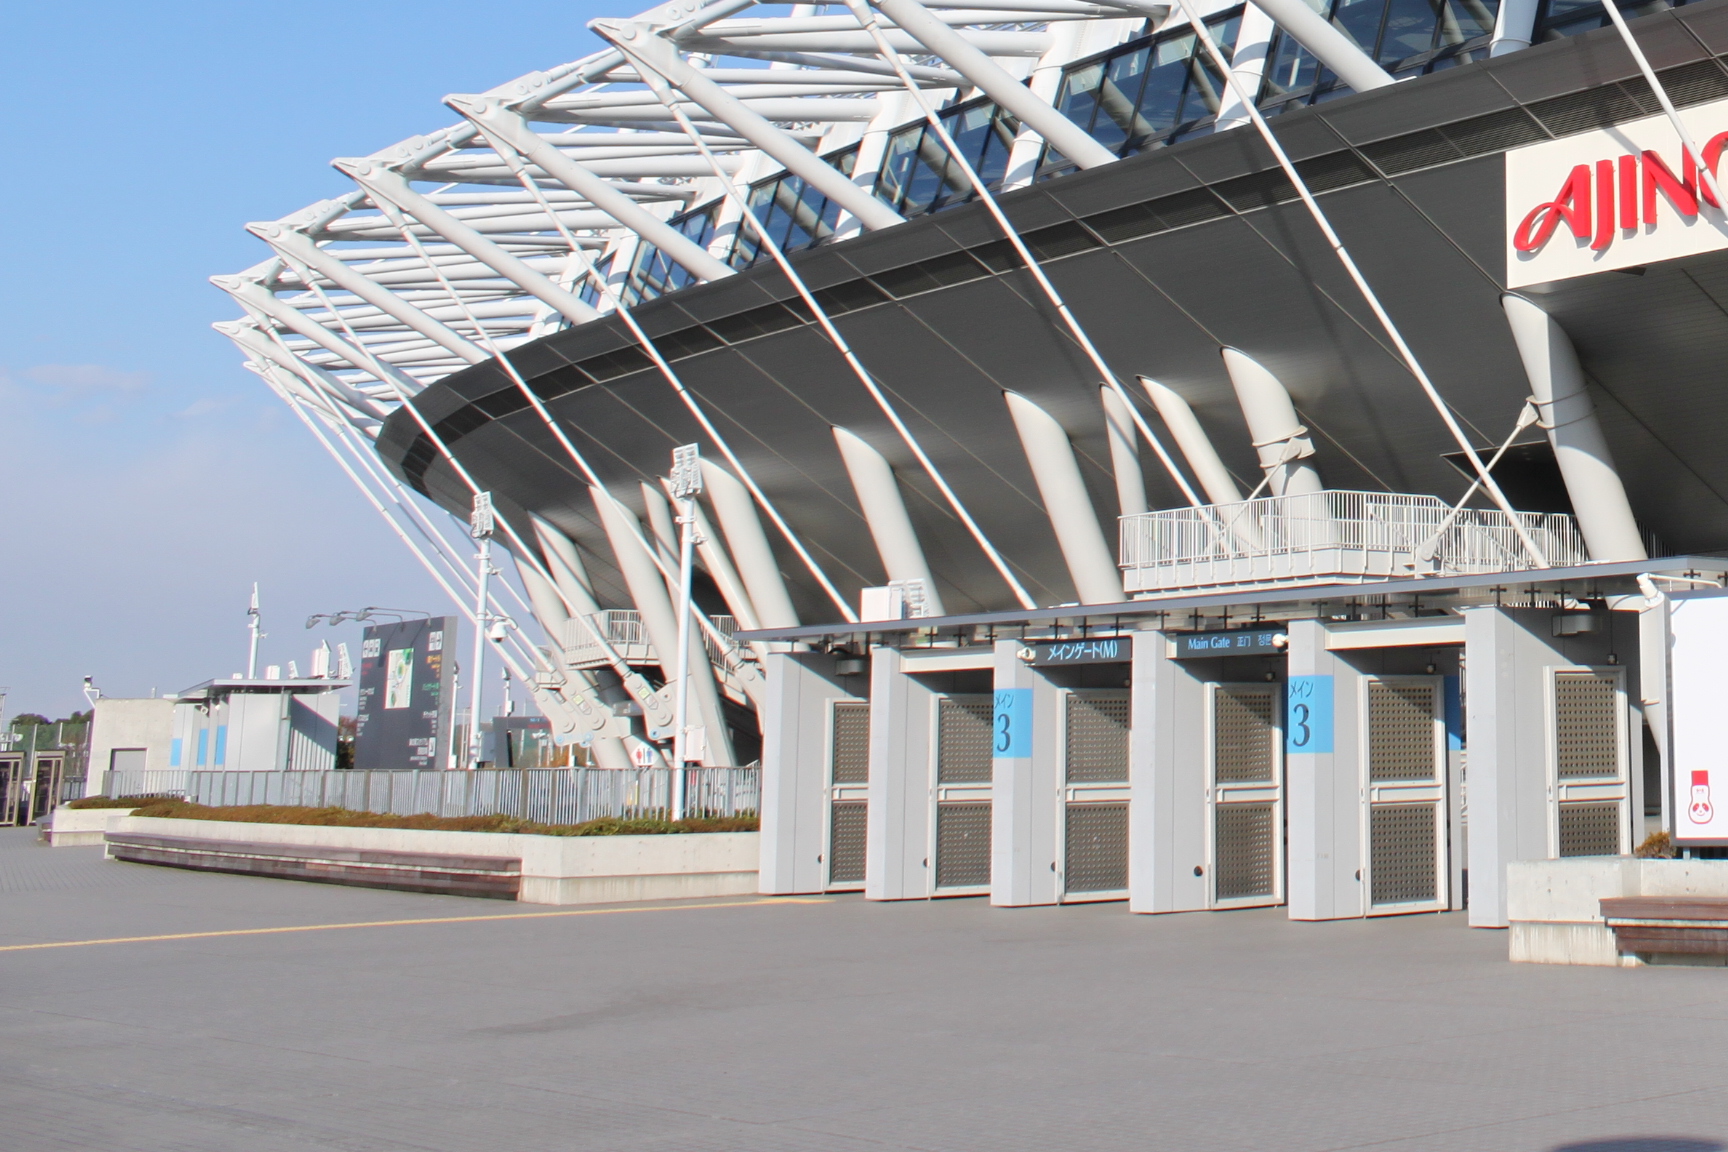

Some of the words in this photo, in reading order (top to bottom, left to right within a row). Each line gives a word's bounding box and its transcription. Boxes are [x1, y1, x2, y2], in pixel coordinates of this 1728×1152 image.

[1048, 640, 1117, 660] メインゲート(M)
[1188, 637, 1209, 650] Main
[1211, 636, 1230, 649] Gate
[1289, 680, 1314, 699] メイン
[994, 693, 1014, 709] メイン
[997, 713, 1011, 752] 3
[1293, 703, 1311, 747] 3
